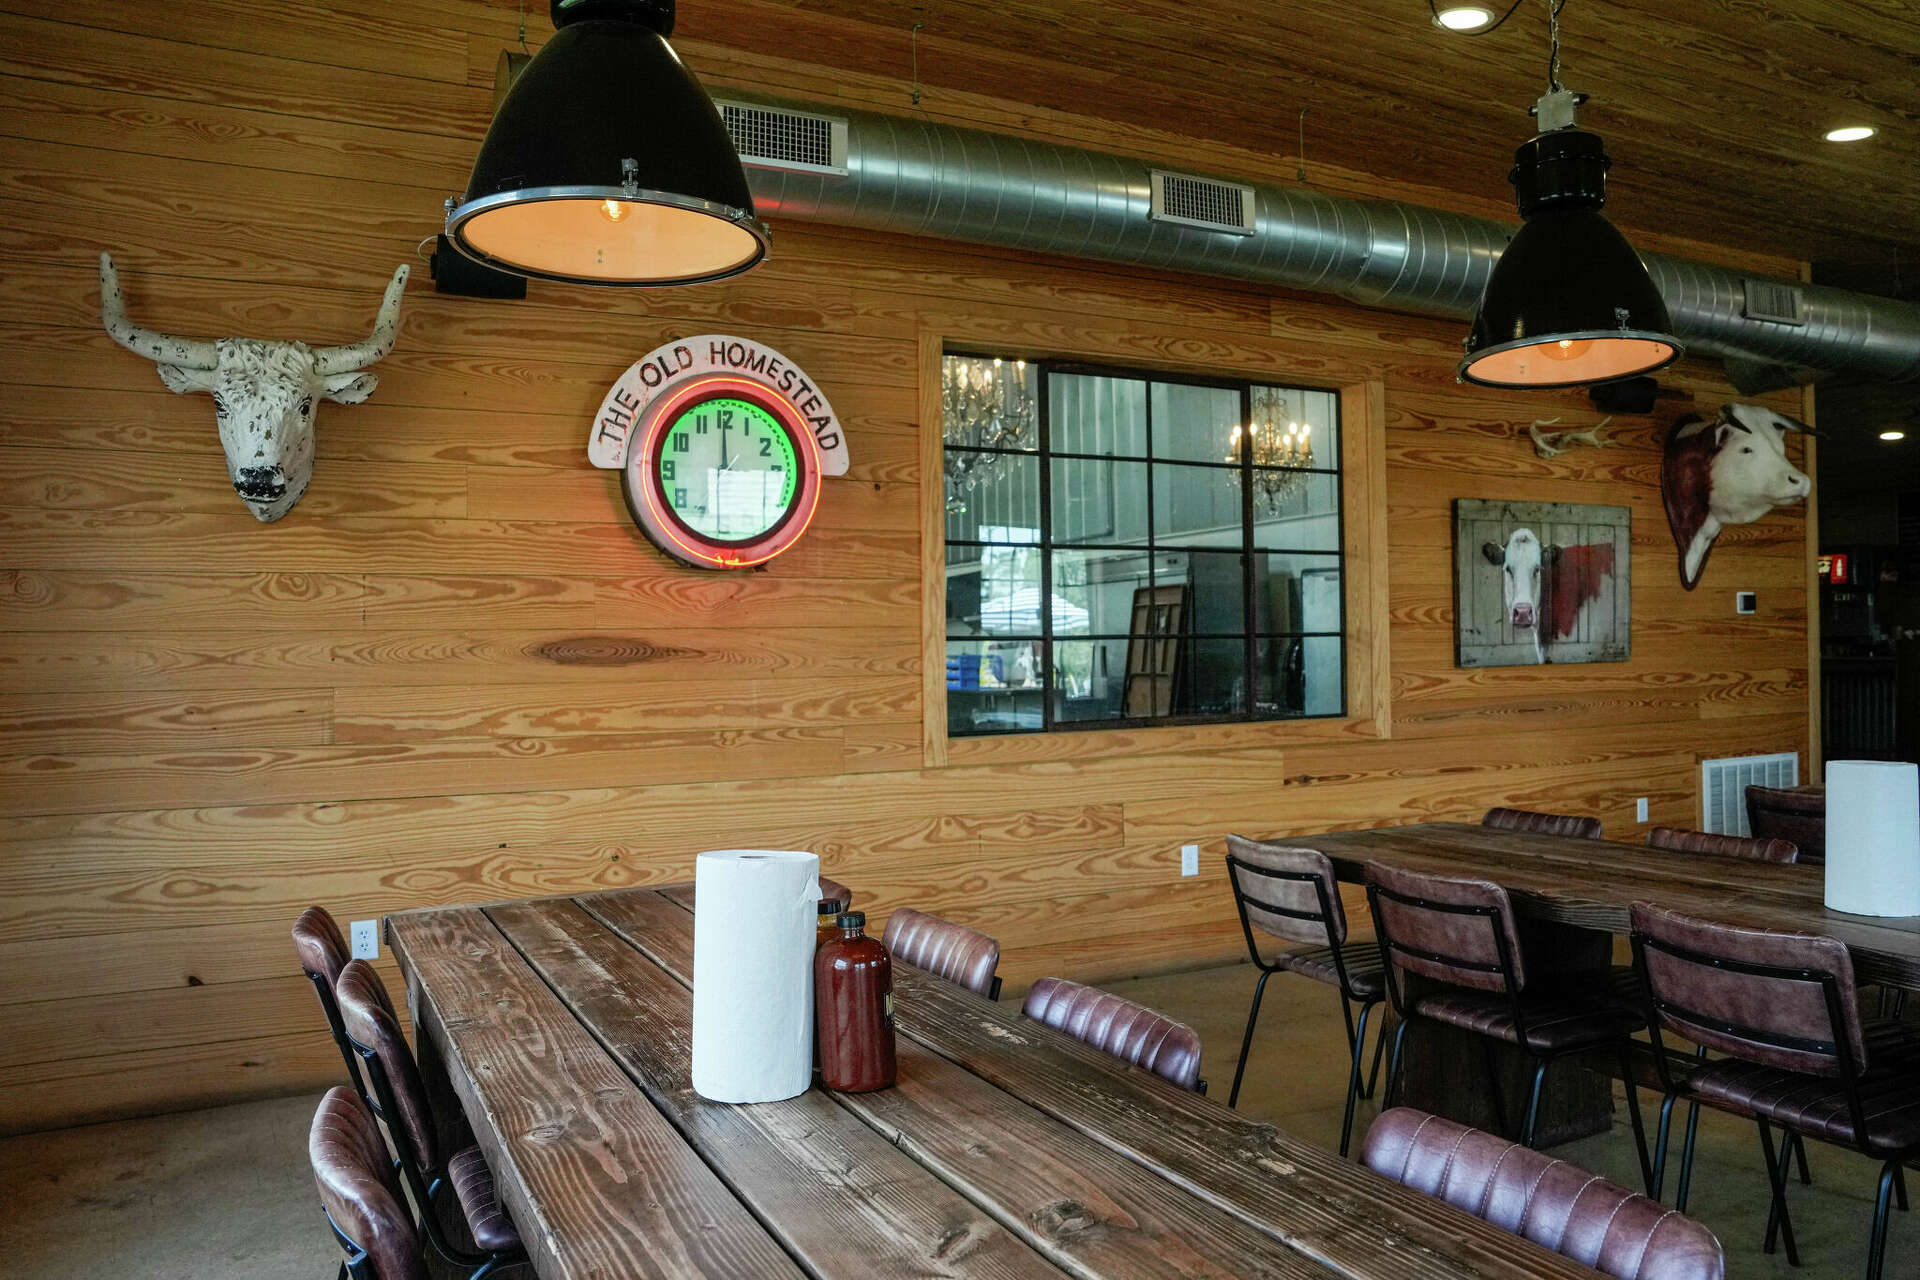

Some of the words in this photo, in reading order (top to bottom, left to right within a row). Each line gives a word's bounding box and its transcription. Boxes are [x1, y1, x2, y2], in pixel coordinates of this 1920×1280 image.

[598, 391, 641, 443] THE
[640, 345, 693, 387] OLD
[709, 341, 839, 452] HOMESTEAD
[696, 415, 708, 434] 11
[717, 410, 733, 429] 12
[673, 432, 690, 452] 10
[759, 437, 771, 456] 2
[663, 460, 675, 480] 9
[675, 488, 687, 508] 8
